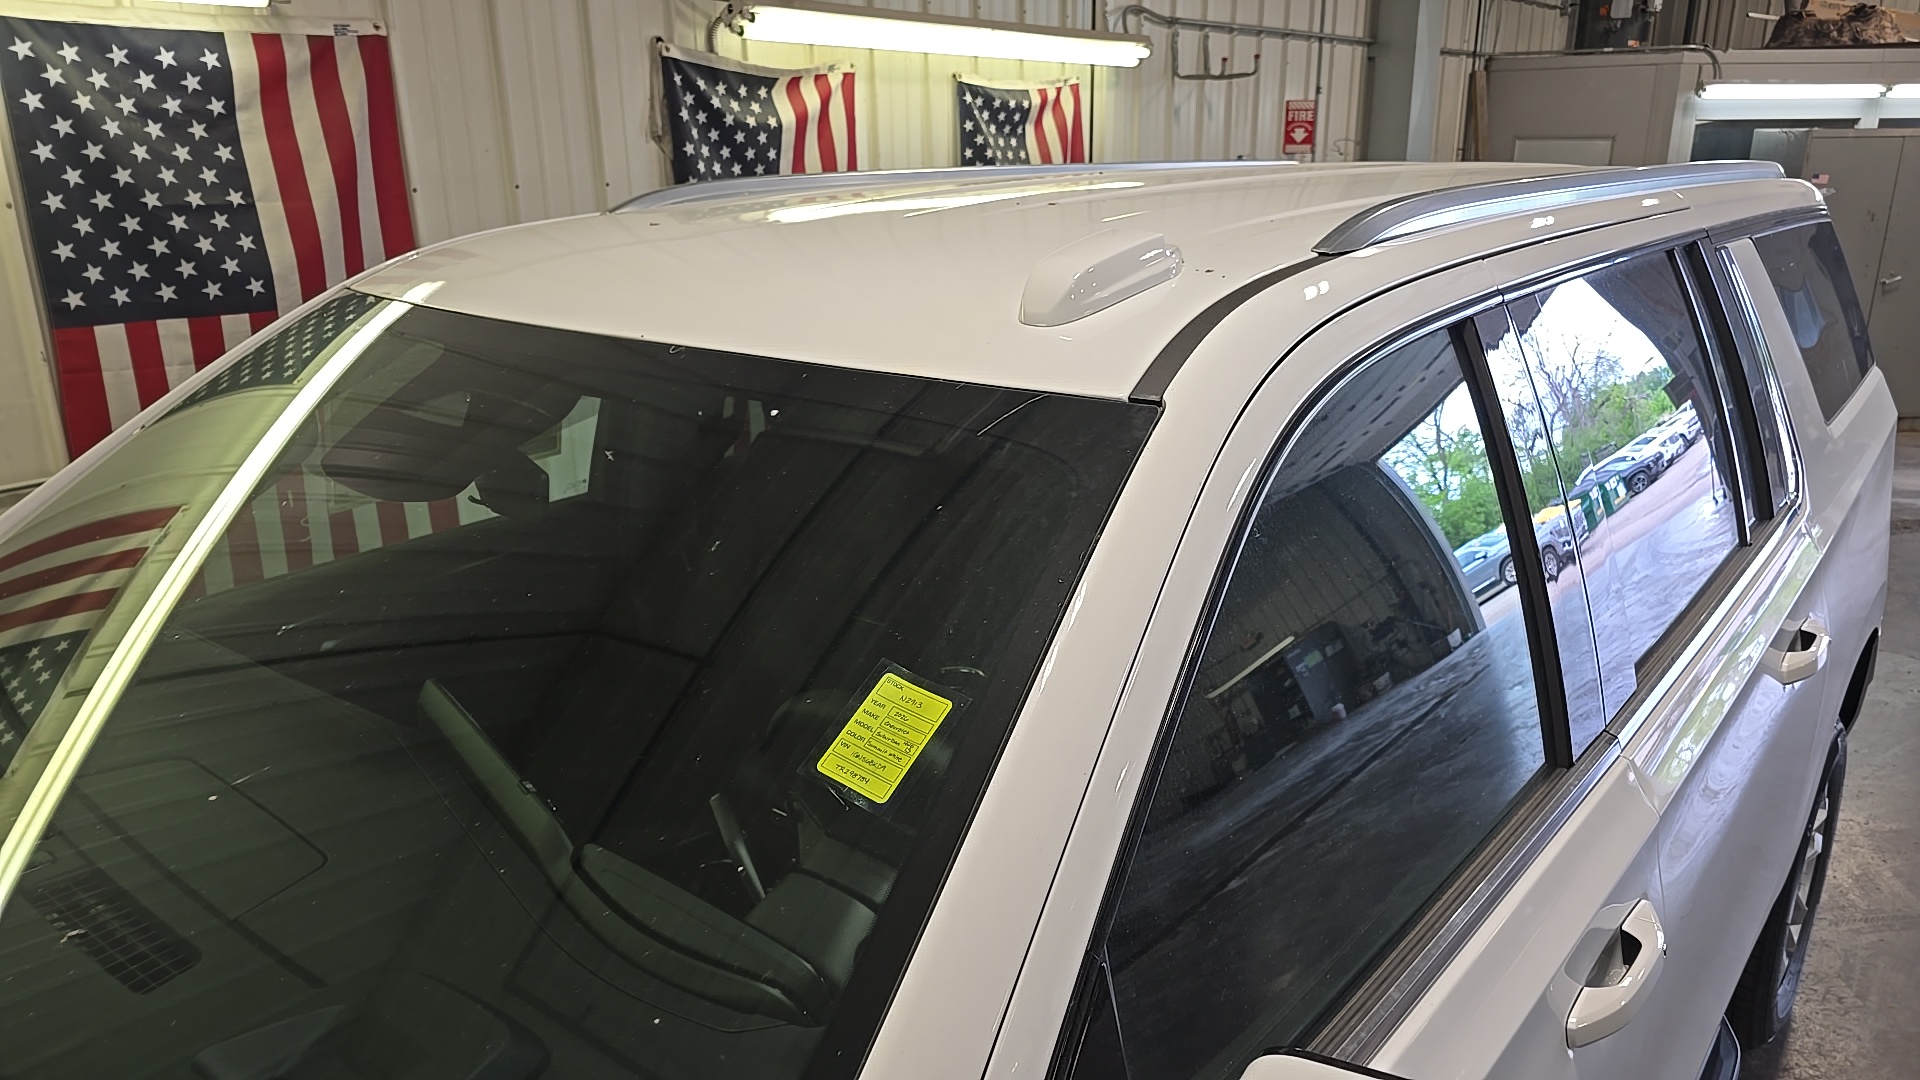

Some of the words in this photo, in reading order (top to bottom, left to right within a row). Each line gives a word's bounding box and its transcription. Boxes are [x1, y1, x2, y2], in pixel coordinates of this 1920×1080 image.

[1288, 110, 1314, 122] FIRE
[886, 679, 904, 691] STOCK
[870, 698, 886, 709] YEAR
[862, 709, 880, 720] MAKE
[854, 719, 874, 732] MODEL
[846, 729, 866, 742] COLOR
[840, 741, 851, 750] VIN
